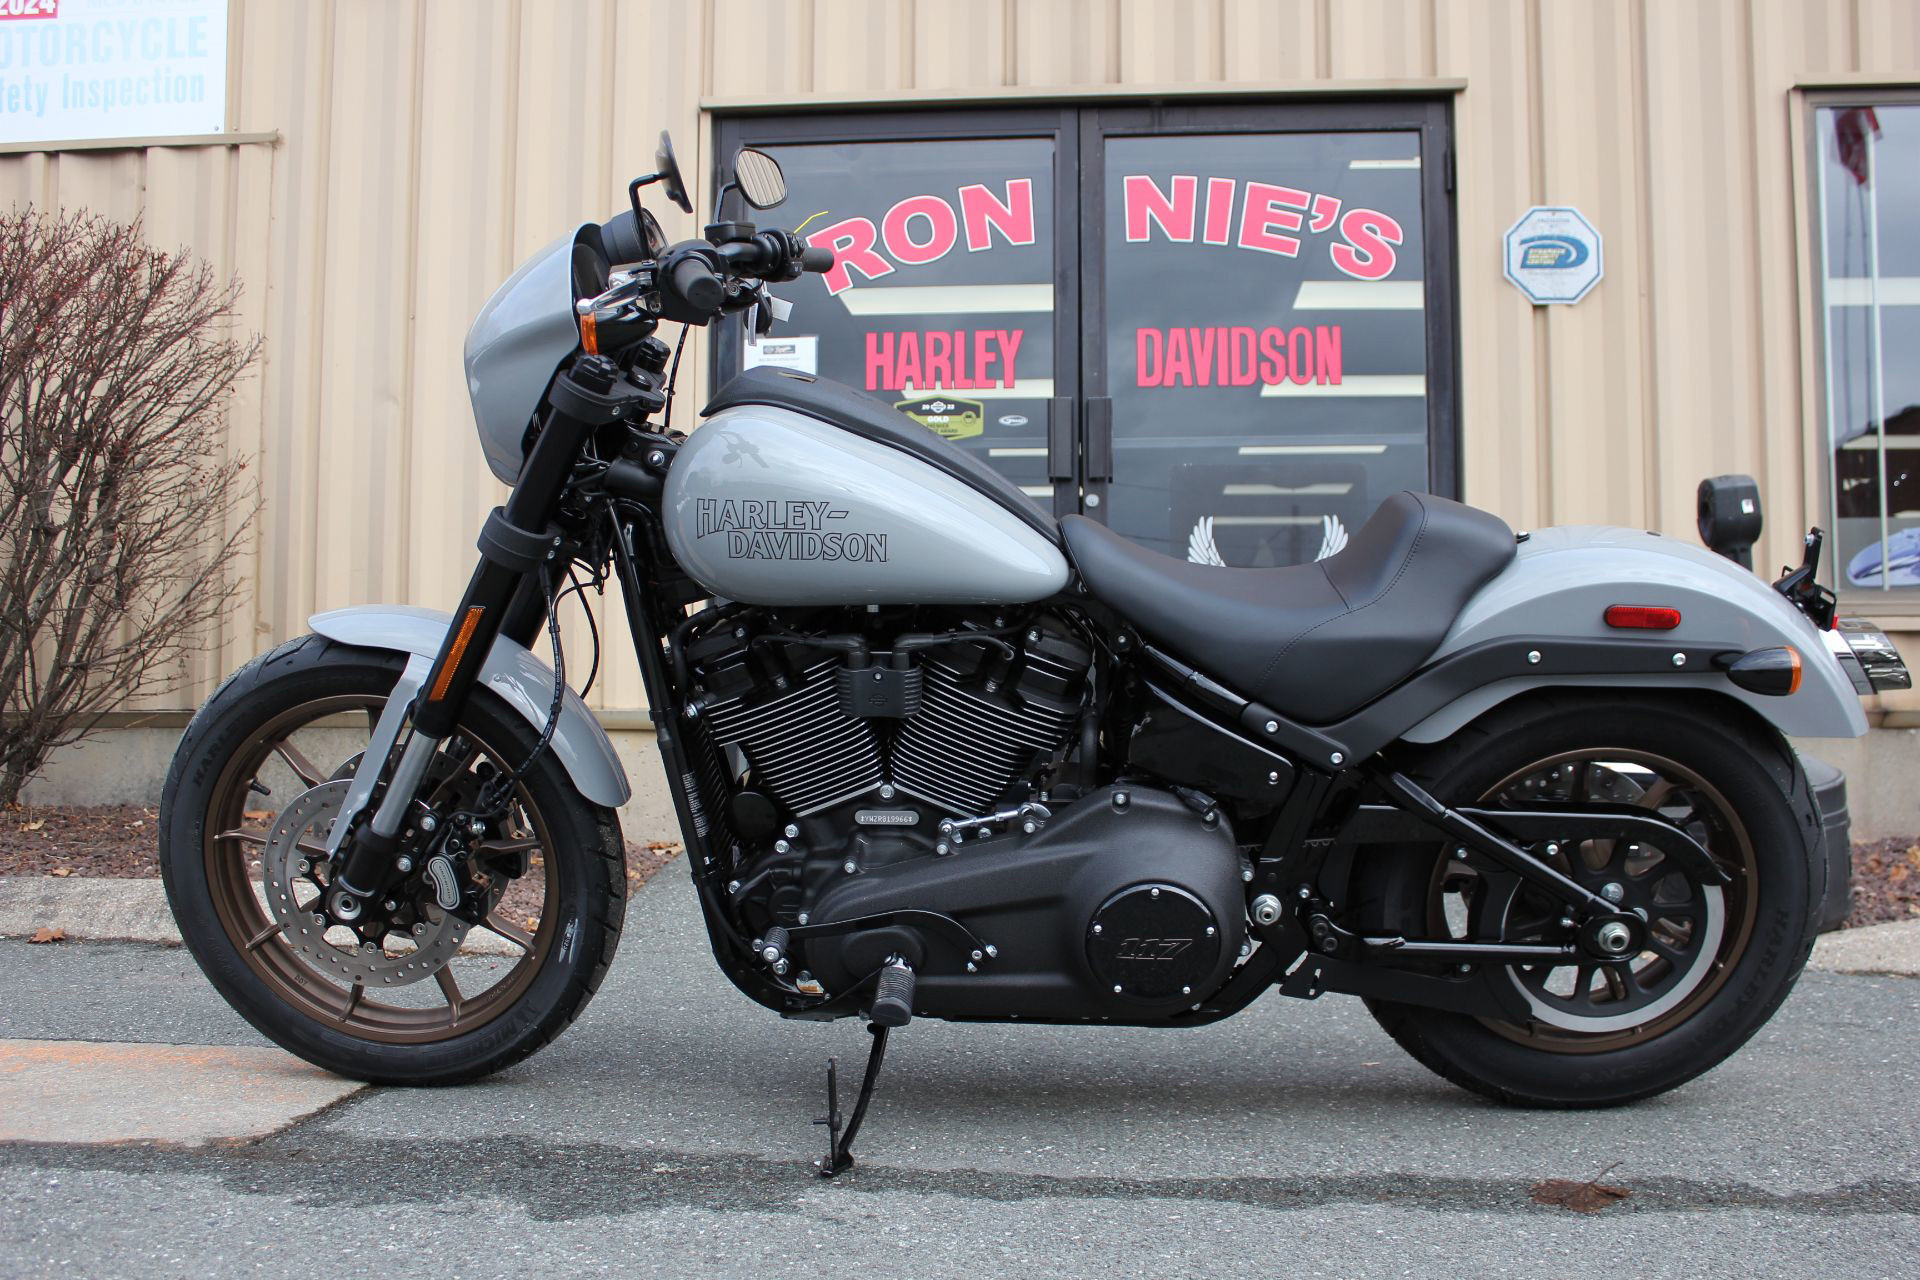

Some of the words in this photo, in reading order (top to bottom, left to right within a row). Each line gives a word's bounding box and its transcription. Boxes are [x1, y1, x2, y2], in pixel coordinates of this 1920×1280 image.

[63, 66, 204, 112] Inspection
[805, 178, 1035, 296] RON
[866, 329, 1024, 391] HARLEY
[1136, 325, 1343, 388] DAVIDSON
[927, 415, 950, 423] GOLD
[696, 498, 849, 539] HARLEY-
[727, 531, 887, 562] DAVIDSON
[1116, 937, 1192, 960] 117
